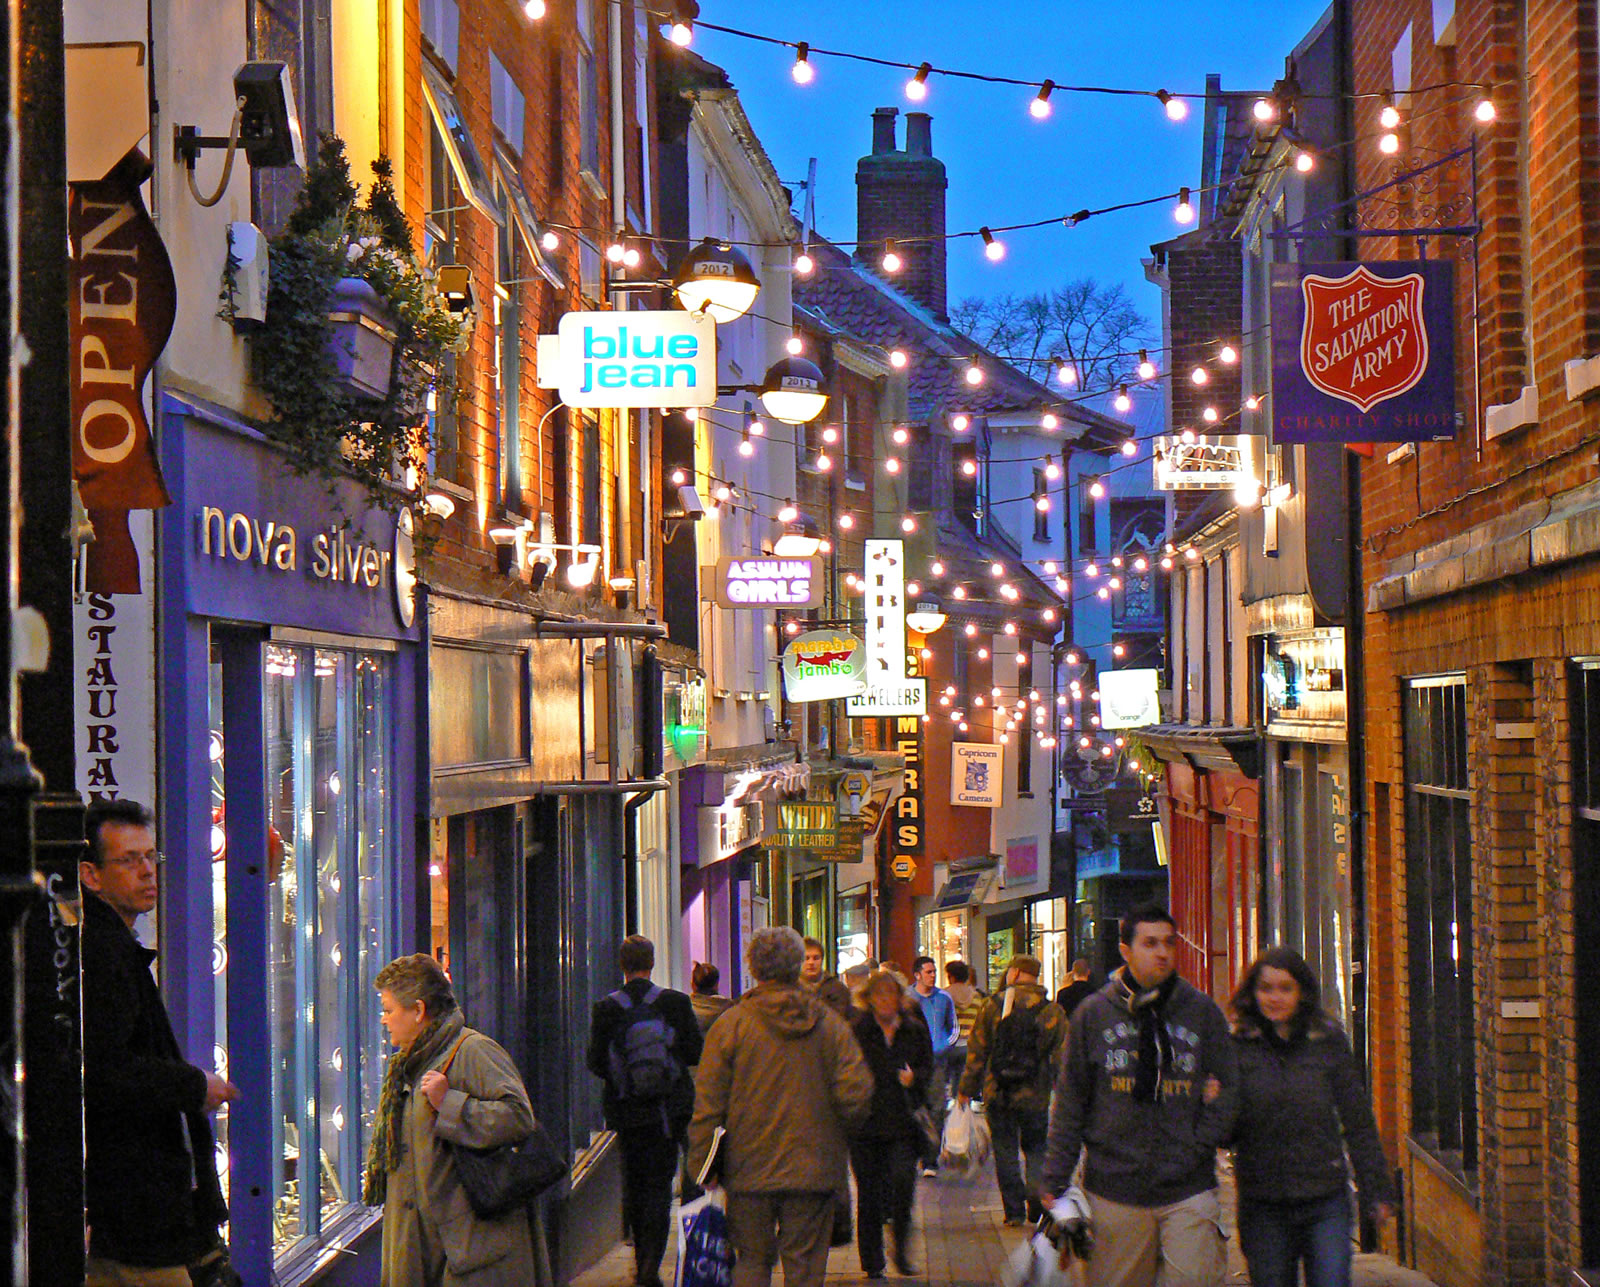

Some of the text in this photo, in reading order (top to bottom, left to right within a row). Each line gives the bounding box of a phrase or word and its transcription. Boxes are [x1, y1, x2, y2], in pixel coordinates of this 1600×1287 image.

[701, 263, 728, 274] 2012
[1328, 287, 1372, 328] THE
[80, 194, 139, 463] OPEN
[1314, 292, 1410, 373] SALVATION
[584, 326, 698, 359] blue
[1349, 329, 1408, 388] ARMY
[580, 362, 697, 393] jean
[1280, 412, 1451, 429] CHARITY SHOP
[203, 506, 391, 588] nova silver
[726, 579, 811, 603] GIRLS
[791, 636, 857, 653] mambo
[799, 660, 853, 680] jambo
[852, 687, 920, 707] JEWELLERS
[897, 655, 920, 847] CMERAS
[958, 748, 997, 758] Capricorn
[958, 793, 992, 802] Cameras
[798, 833, 835, 847] LEATHER
